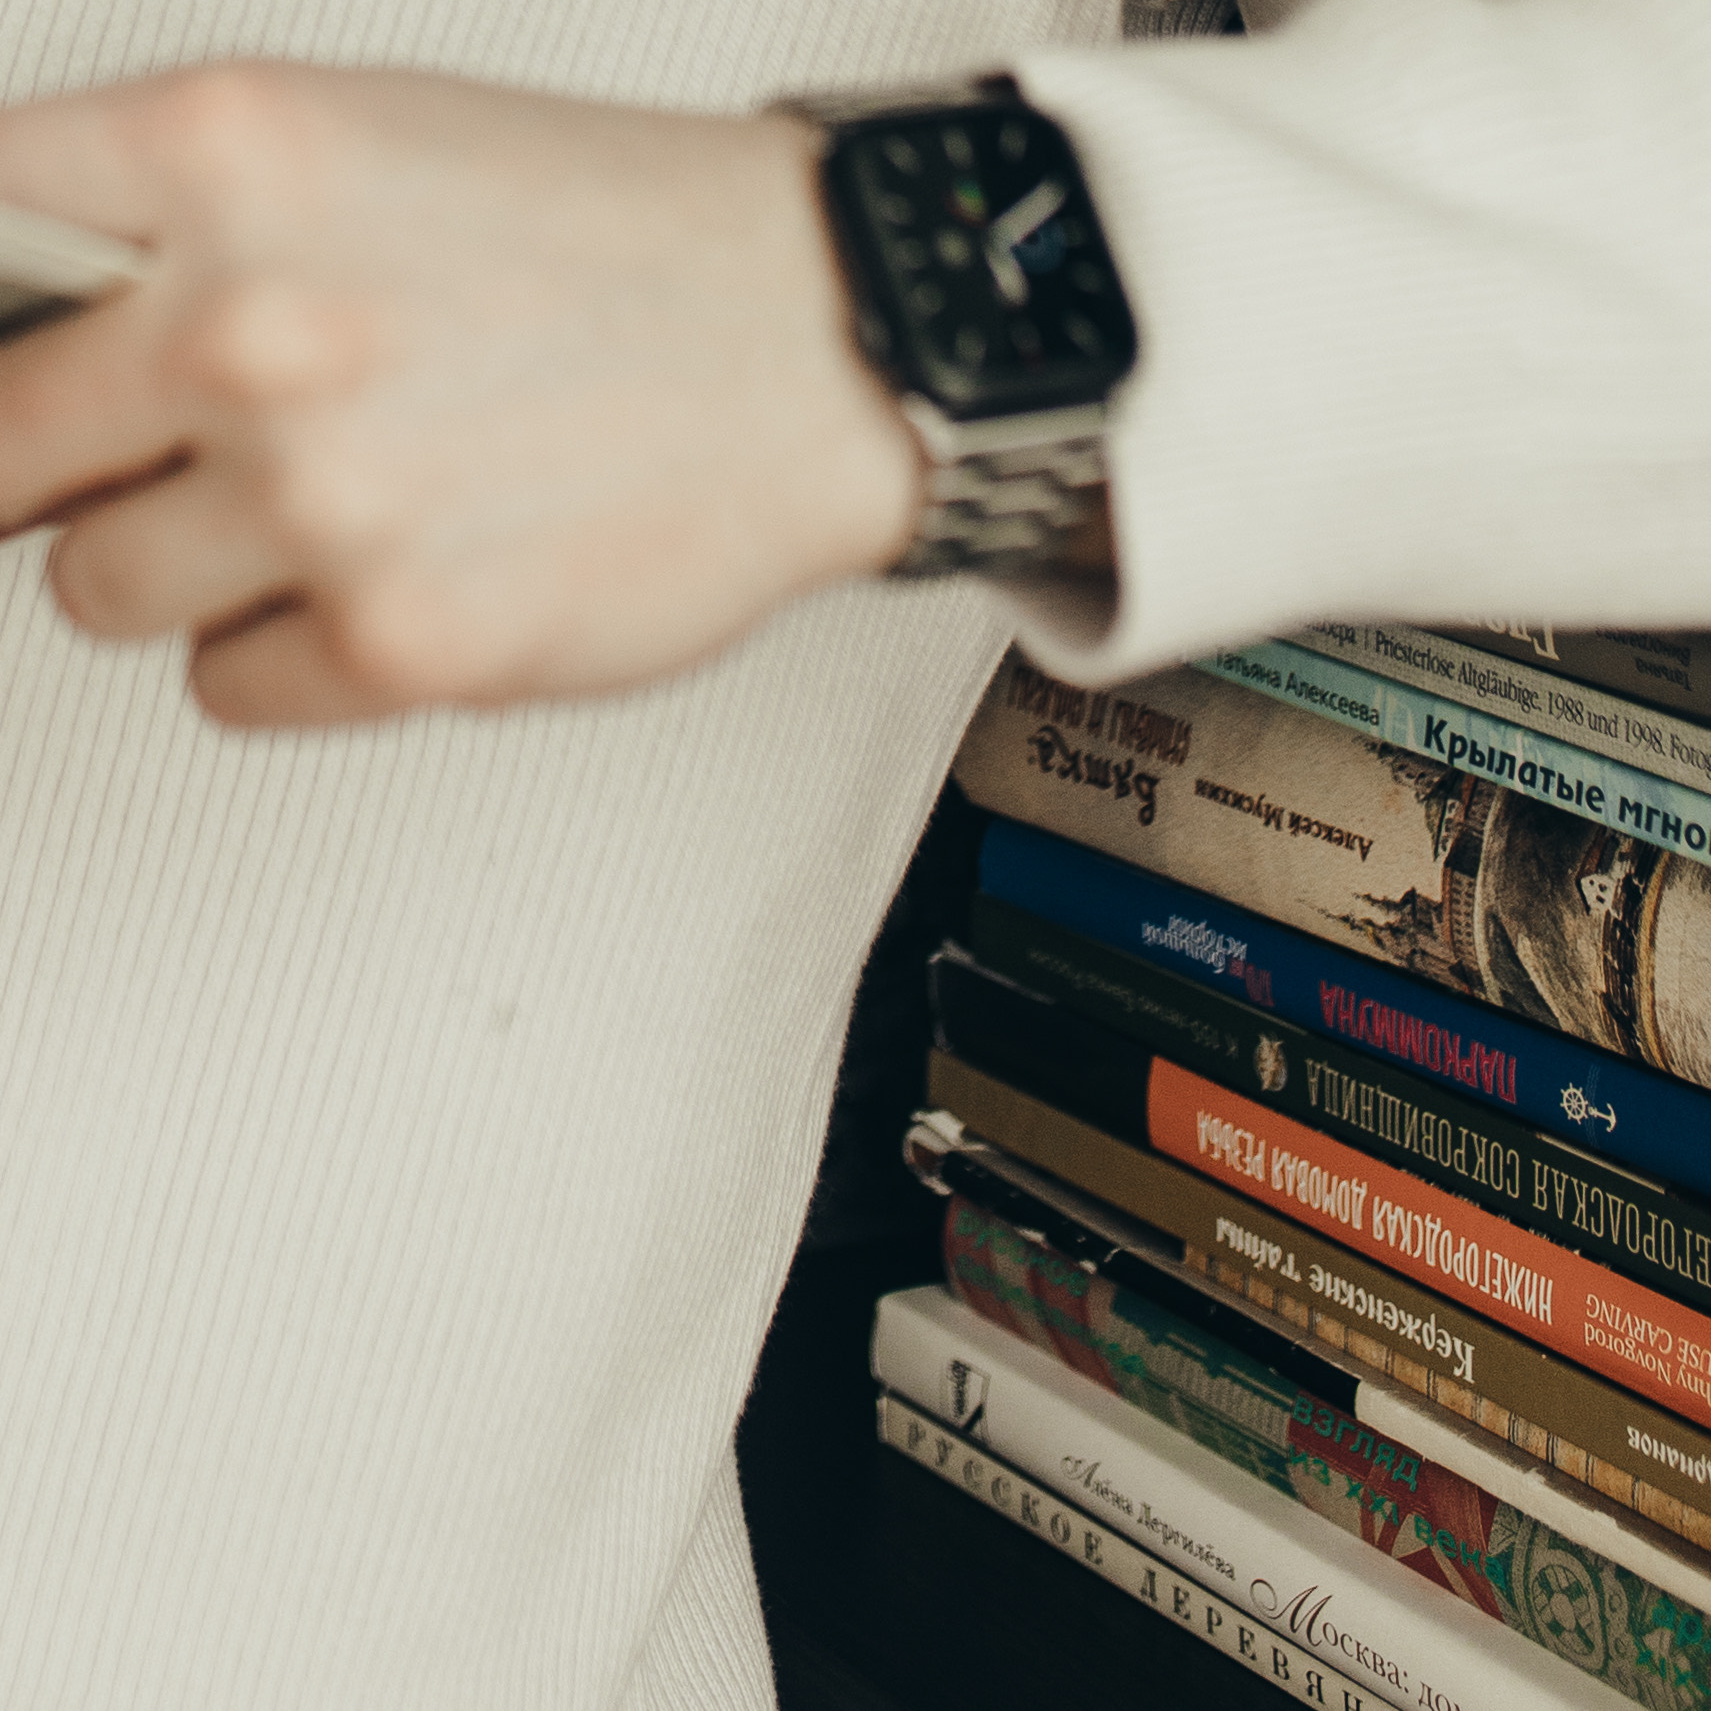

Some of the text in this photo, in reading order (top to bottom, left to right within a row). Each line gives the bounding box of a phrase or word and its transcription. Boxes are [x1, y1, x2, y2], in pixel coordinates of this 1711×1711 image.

[1216, 647, 1381, 725] Татьяна Алексеева
[1375, 630, 1456, 679] Priesterlose
[1547, 695, 1584, 726] 1988
[1587, 711, 1619, 738] und
[1635, 658, 1694, 692] Татьяна
[1194, 779, 1374, 862] Алексей Мусихин
[1424, 715, 1711, 854] Крылатые мгно
[1318, 980, 1518, 1105] ПАРКОММУНА
[1196, 1109, 1267, 1177] РЕЗЬБА
[1305, 1057, 1520, 1199] СОКРОВИЩНИЦА
[1271, 1149, 1368, 1230] ДОМОВАЯ
[1373, 1196, 1554, 1325] НИЖЕГОРОДСКАЯ
[1310, 1263, 1477, 1385] Керженские
[1584, 1322, 1672, 1386] Novgorod
[1585, 1293, 1673, 1355] CARVING
[905, 1418, 1364, 1711] РУССКОЕ ДЕРЕВЯН
[1059, 1452, 1237, 1582] Алёна Дергилёва
[1249, 1577, 1461, 1711] Москва: до
